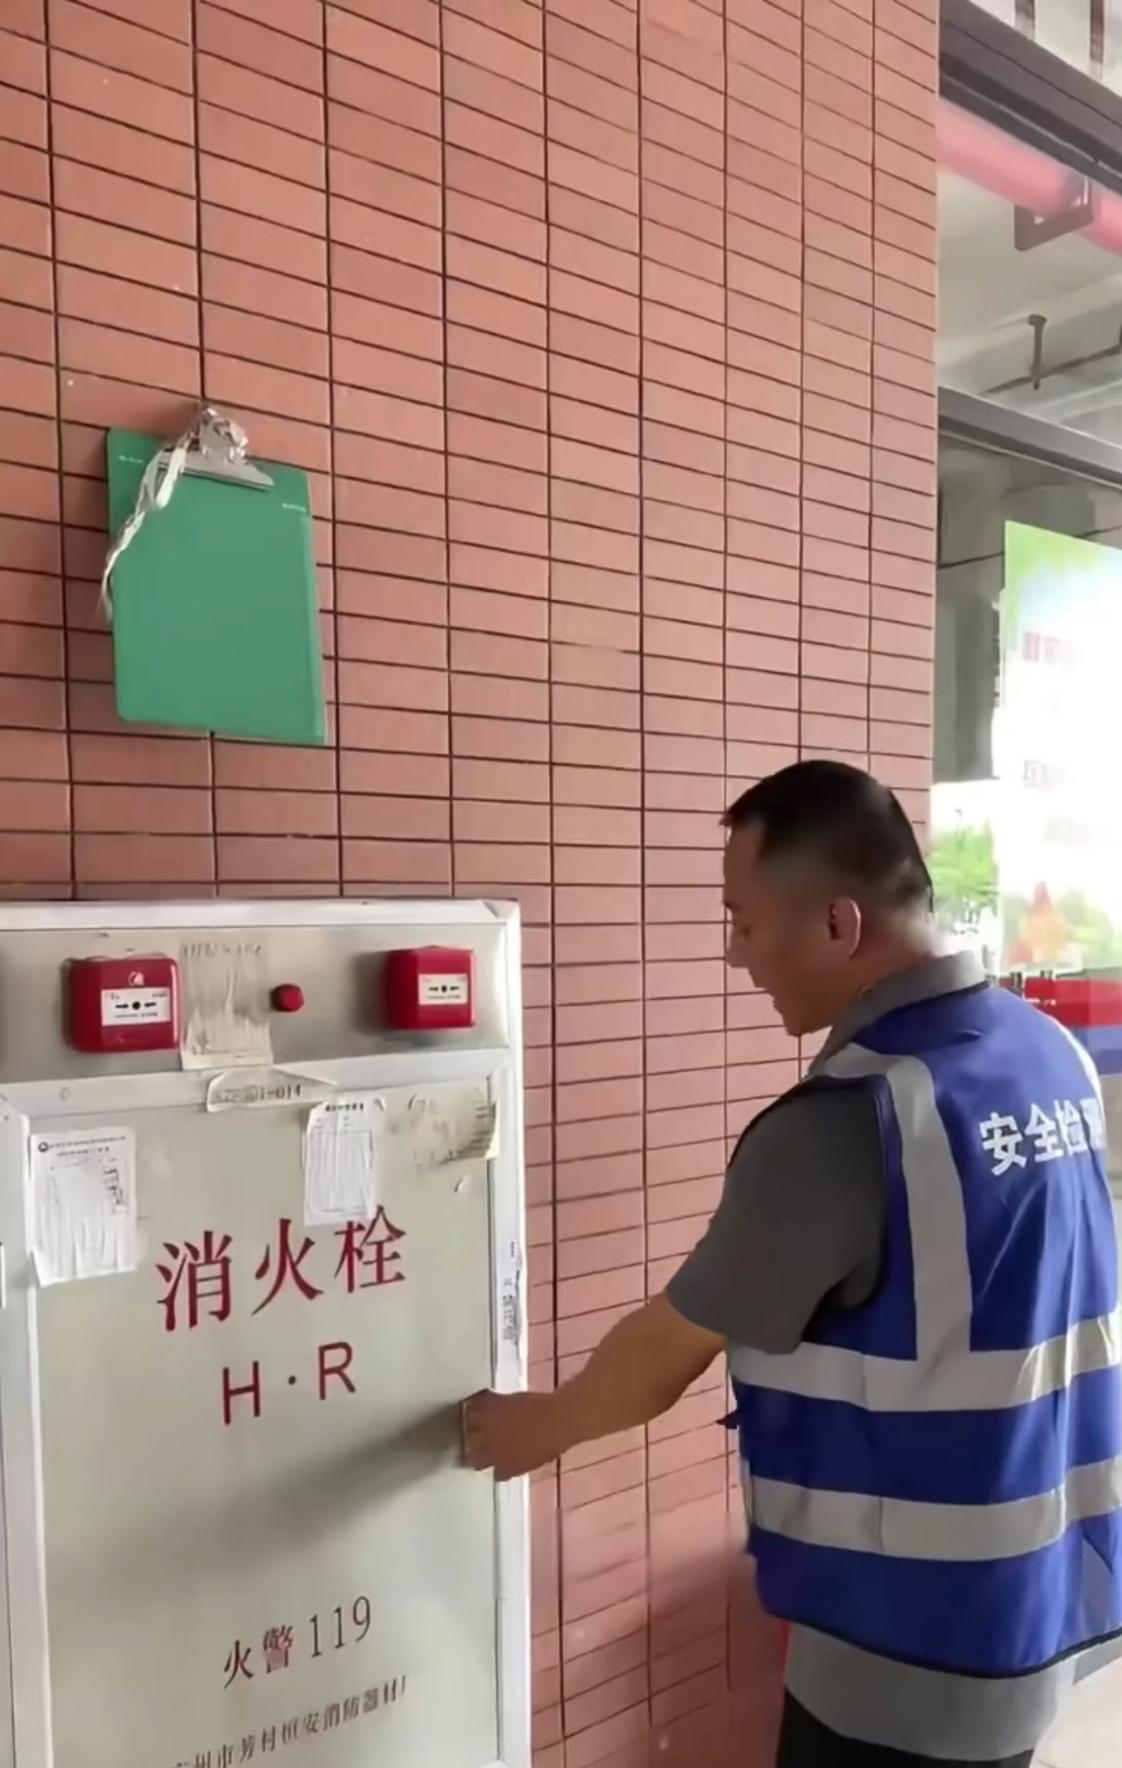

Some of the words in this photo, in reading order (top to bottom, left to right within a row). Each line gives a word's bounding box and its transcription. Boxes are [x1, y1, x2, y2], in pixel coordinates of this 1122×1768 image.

[155, 1204, 407, 1332] 消火栓
[309, 1596, 371, 1658] 119
